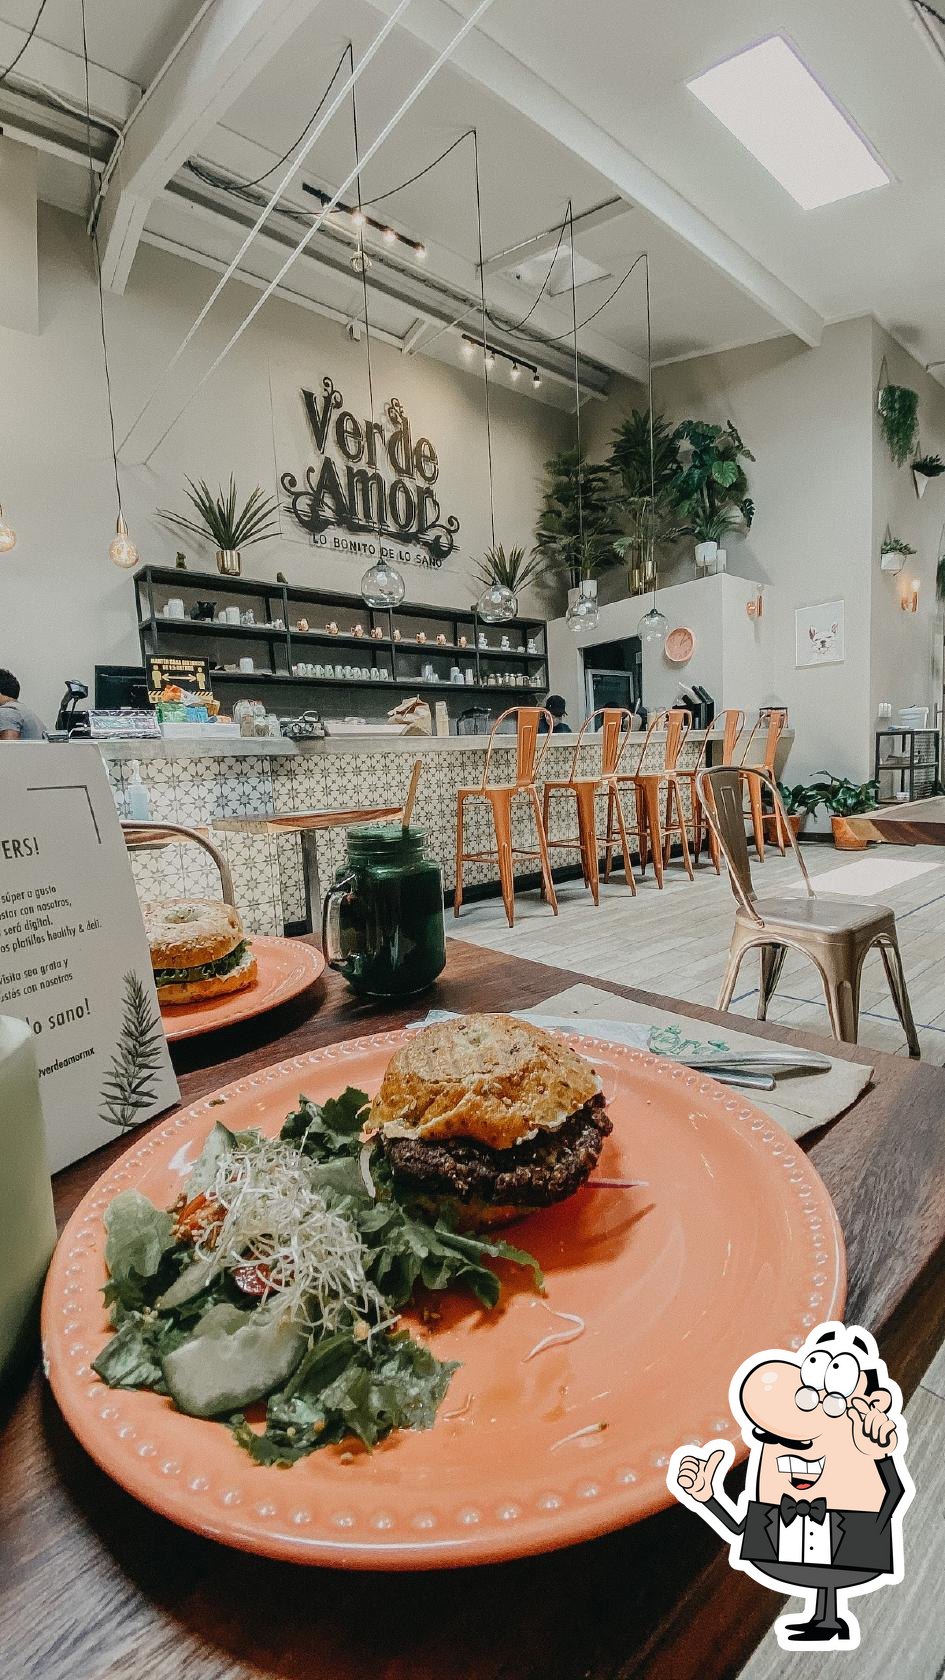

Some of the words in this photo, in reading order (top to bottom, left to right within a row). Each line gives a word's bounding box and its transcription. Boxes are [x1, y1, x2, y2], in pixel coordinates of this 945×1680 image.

[300, 377, 439, 485] Verde
[281, 456, 459, 550] Amor
[312, 533, 327, 545] LO
[333, 537, 376, 555] BONITO
[381, 547, 394, 559] DE
[399, 550, 411, 562] LO
[416, 554, 442, 568] SANO
[27, 890, 33, 898] a
[35, 885, 57, 899] gusto
[0, 909, 17, 920] star
[20, 906, 35, 916] con
[36, 898, 72, 912] nosotros,
[3, 922, 22, 936] será
[24, 914, 53, 931] digital.
[12, 933, 46, 952] platillos
[46, 926, 76, 941] healthy
[78, 923, 85, 933] &
[86, 917, 102, 931] deli.
[23, 969, 38, 979] sea
[40, 960, 61, 975] grata
[62, 958, 69, 969] y
[23, 984, 38, 995] con
[40, 972, 73, 990] nosotros
[48, 997, 91, 1029] sano!
[38, 1047, 95, 1078] verdeamormx
